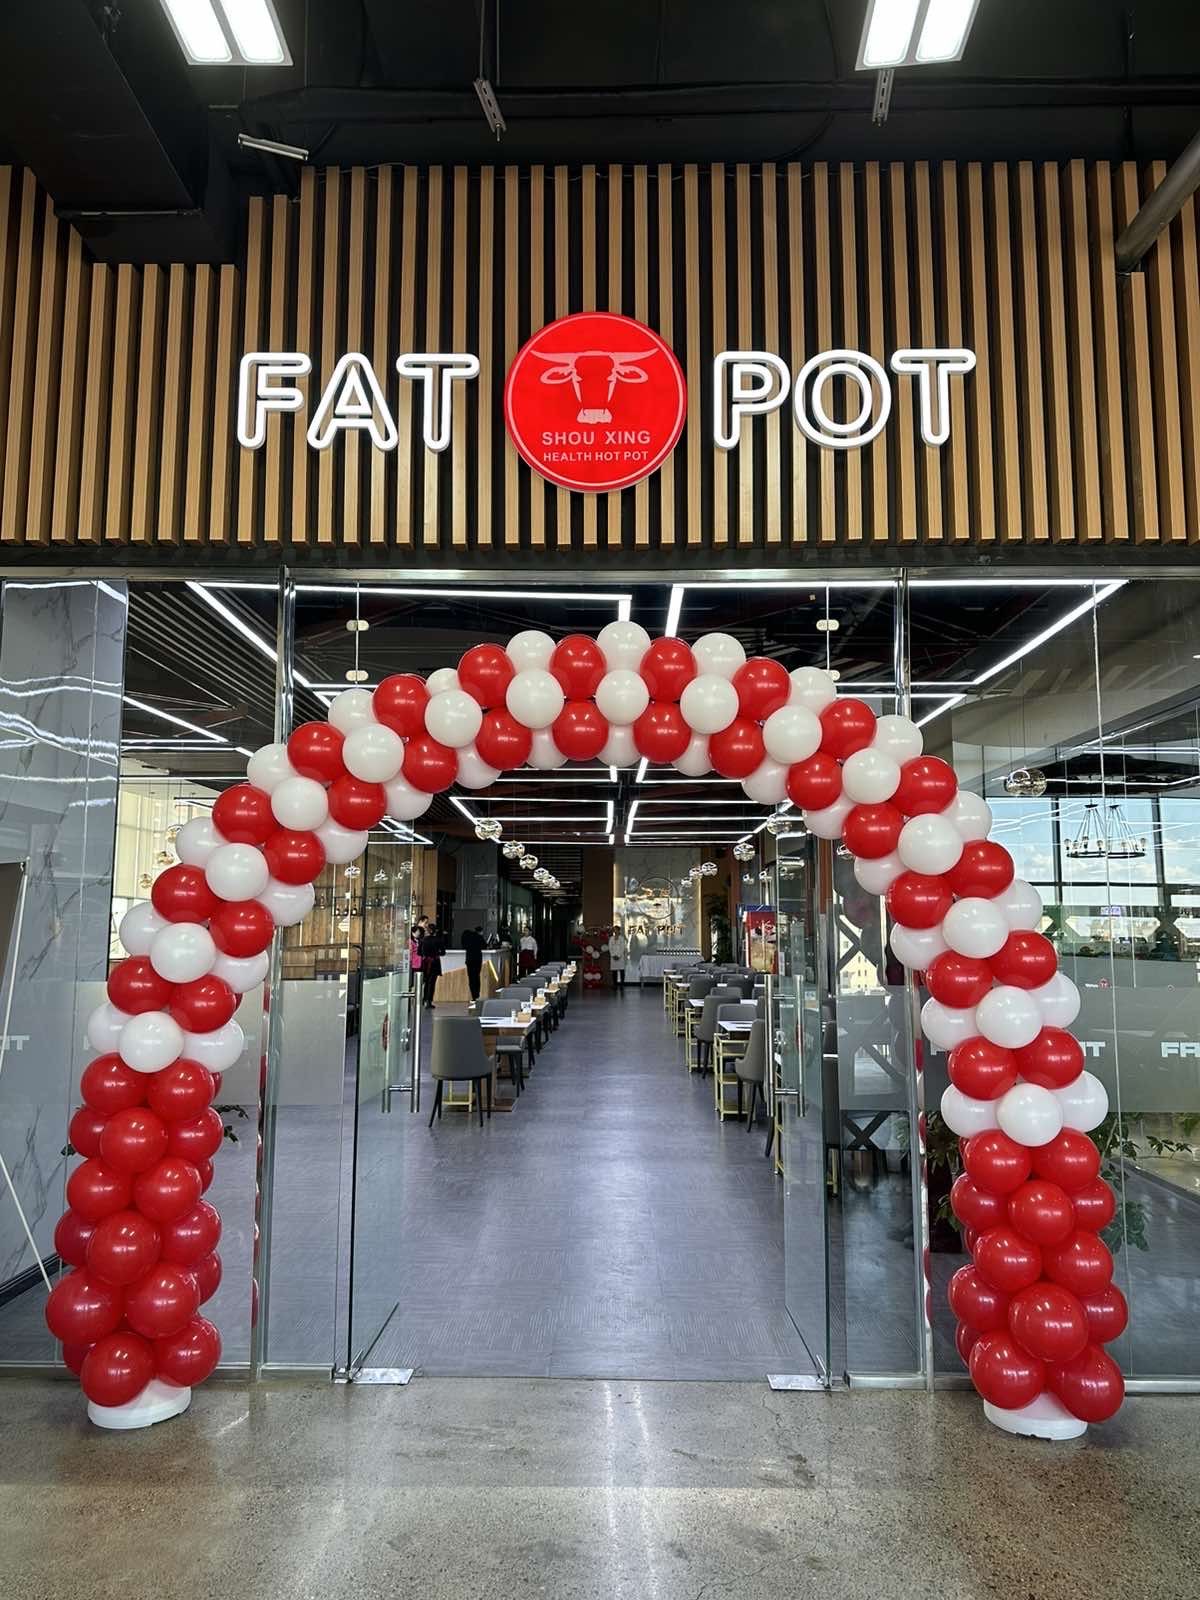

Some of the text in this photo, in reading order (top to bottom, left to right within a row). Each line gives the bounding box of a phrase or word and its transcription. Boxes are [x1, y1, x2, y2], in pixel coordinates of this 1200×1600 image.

[237, 348, 977, 452] FAT POT
[541, 430, 651, 446] SHOU XING
[543, 450, 649, 462] HEALTH HOT POT
